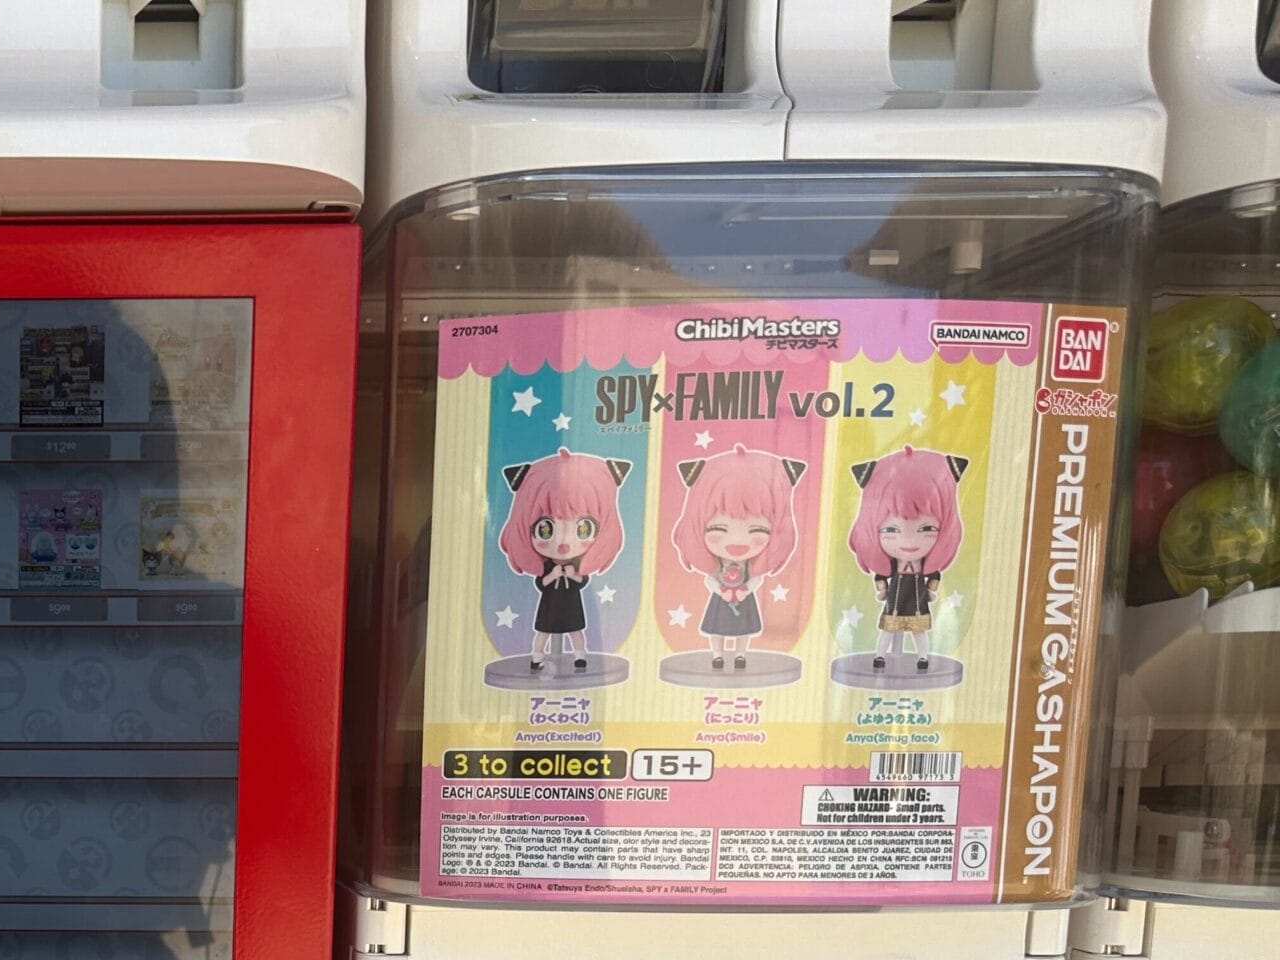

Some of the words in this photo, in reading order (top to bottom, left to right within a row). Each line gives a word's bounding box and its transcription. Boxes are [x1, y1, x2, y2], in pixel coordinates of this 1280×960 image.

[451, 325, 499, 338] 2707304
[936, 327, 981, 341] BANDAI
[982, 329, 1025, 342] NAMCO
[1061, 328, 1102, 351] BAN
[1059, 350, 1091, 371] DAI
[789, 381, 895, 420] vol.2
[1044, 423, 1090, 626] PREMIUM
[531, 697, 591, 710] アーニャ
[704, 696, 763, 710] アーニャ
[869, 697, 924, 711] アーニャ
[696, 732, 766, 744] Anya(Smile)
[846, 733, 908, 744] Anya(Smug
[911, 733, 940, 744] face)
[1023, 631, 1070, 877] GASHAPON
[452, 754, 468, 776] 3
[479, 754, 507, 776] to
[519, 753, 612, 776] collect
[643, 755, 703, 776] 15+
[852, 787, 931, 802] WARNING:
